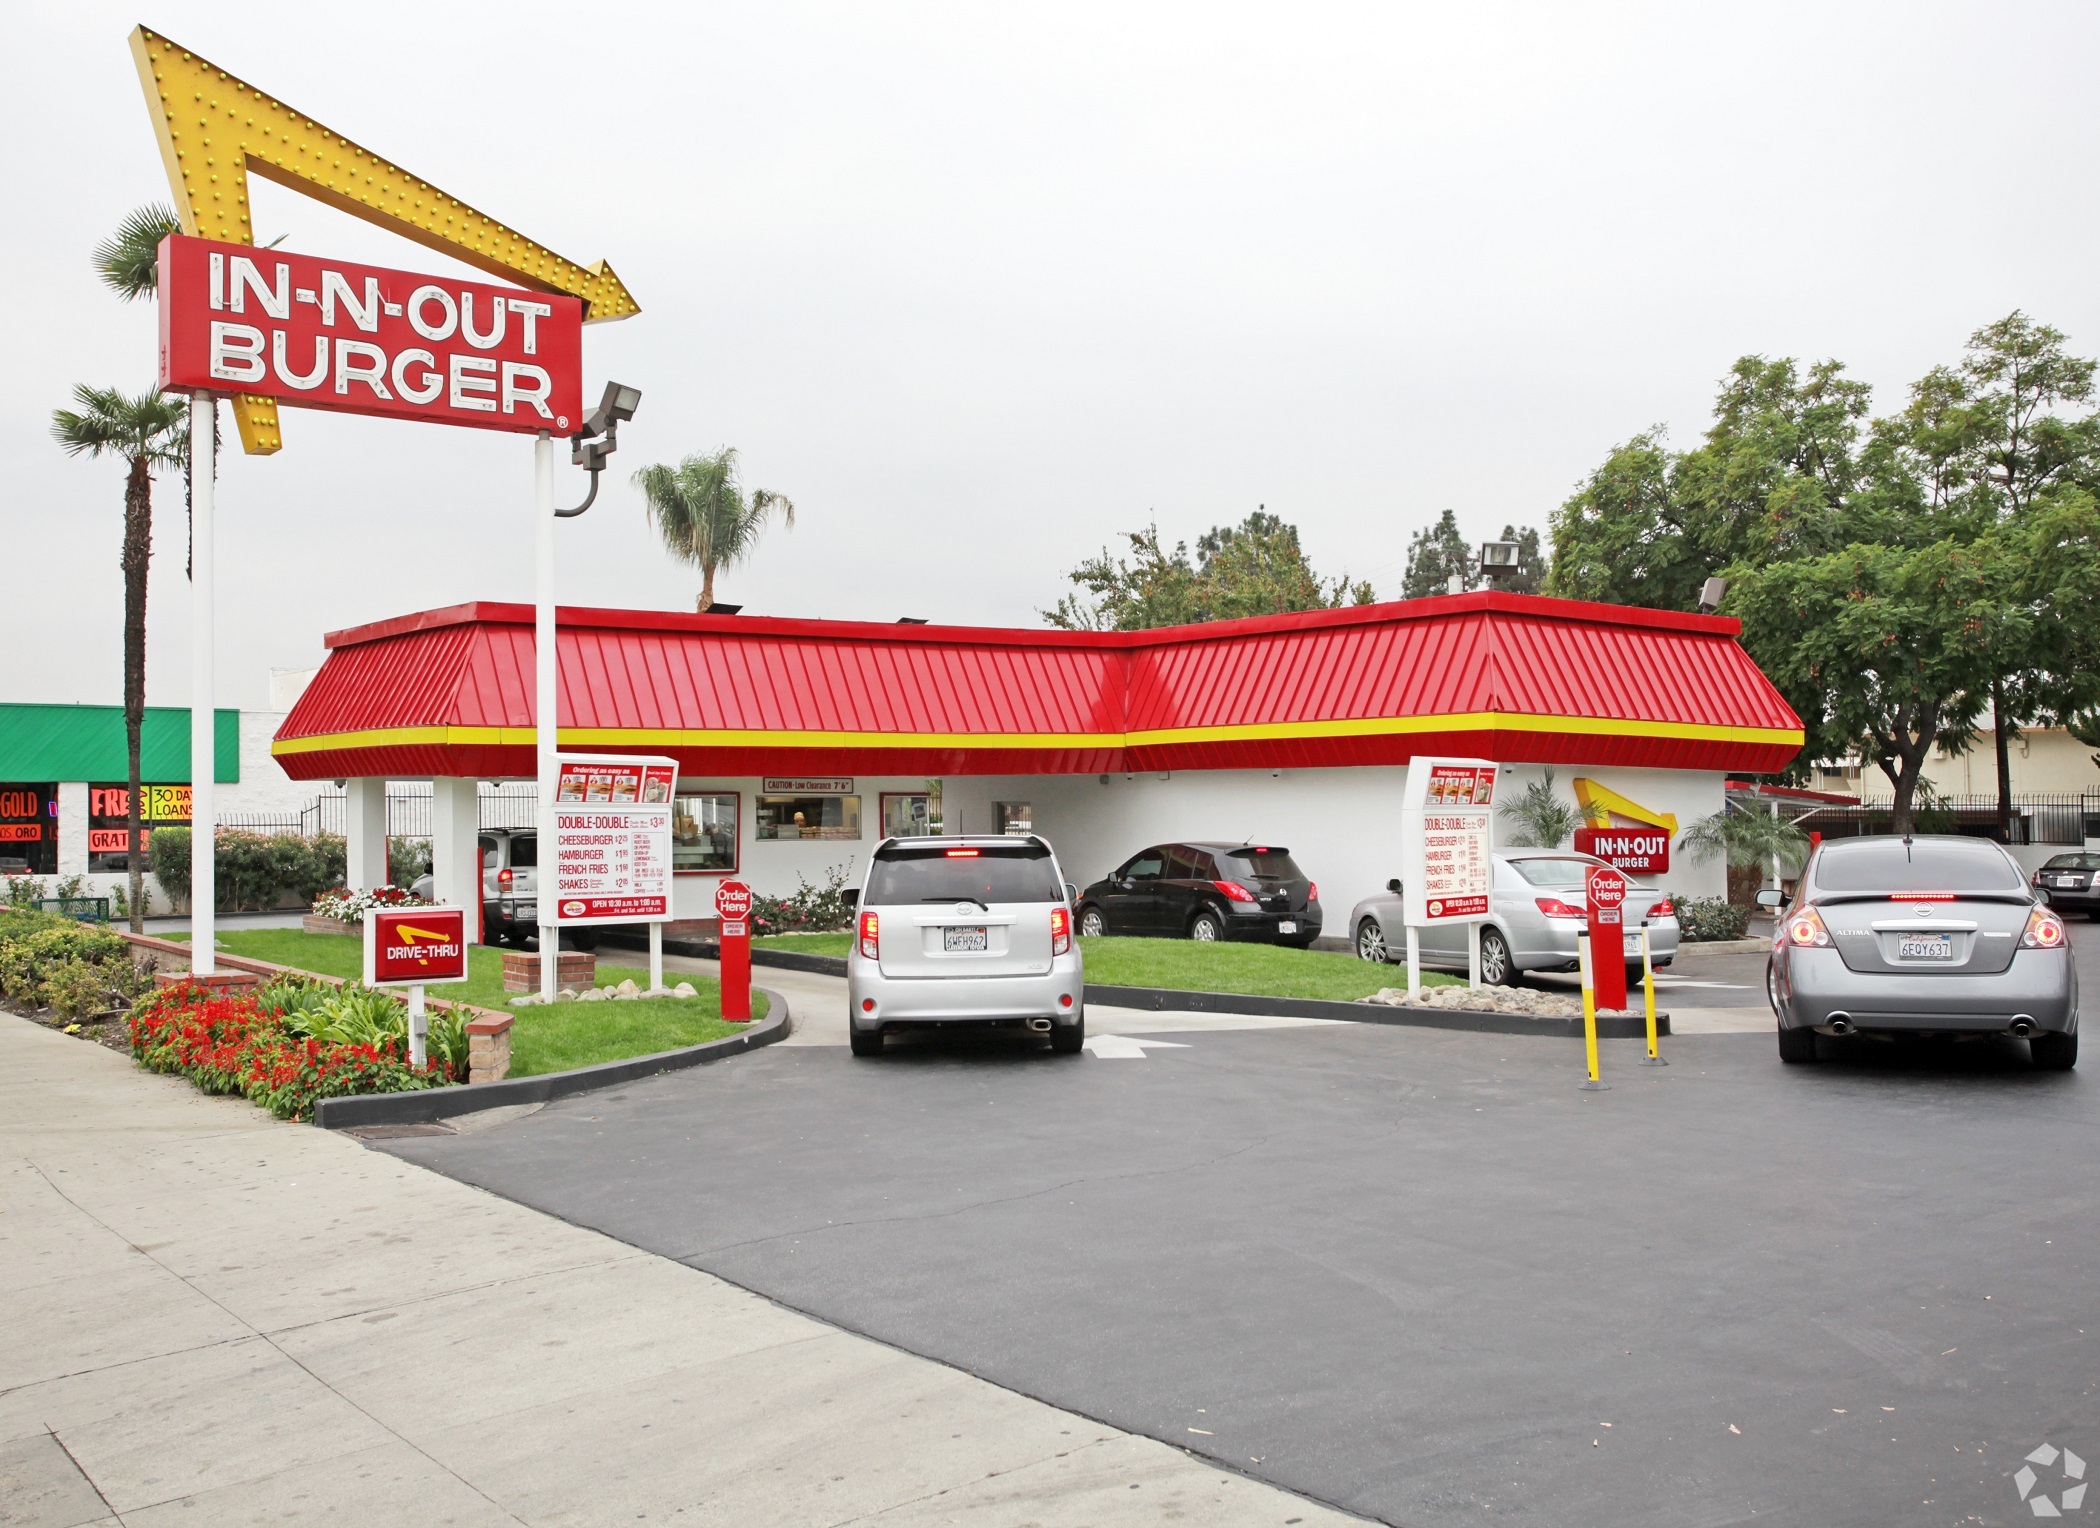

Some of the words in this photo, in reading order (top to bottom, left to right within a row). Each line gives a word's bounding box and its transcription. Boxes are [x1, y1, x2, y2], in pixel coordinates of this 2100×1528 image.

[209, 252, 551, 356] IN-N-OUT
[209, 320, 555, 420] BURGER
[572, 766, 599, 775] Ordering
[806, 782, 832, 790] Clearance
[154, 789, 173, 803] 30
[1, 791, 38, 818] GOLD
[558, 816, 629, 829] DOUBLE-DOUBLE
[1425, 818, 1466, 830] DOUBLE-DOUBLE
[15, 827, 37, 838] ORO
[92, 832, 130, 847] GRAT
[558, 834, 614, 846] CHEESEBURGER
[1425, 836, 1458, 847] CHEESEBURGER
[558, 850, 604, 860] HAMBURGER
[1425, 851, 1452, 861] HAMBURGER
[1612, 857, 1649, 868] BURGER
[559, 864, 587, 875] FRENCH
[589, 864, 608, 874] FRIES
[1426, 865, 1443, 875] FRENCH
[1444, 864, 1455, 874] FRIES
[559, 878, 588, 889] SHAKES
[1427, 880, 1444, 890] SHAKES
[1592, 878, 1624, 889] Order
[717, 889, 749, 901] Order
[1595, 890, 1621, 901] Here
[592, 900, 607, 908] OPEN
[640, 898, 650, 906] 1:00
[720, 901, 747, 912] Here
[387, 944, 459, 960] DRIVE-THRU
